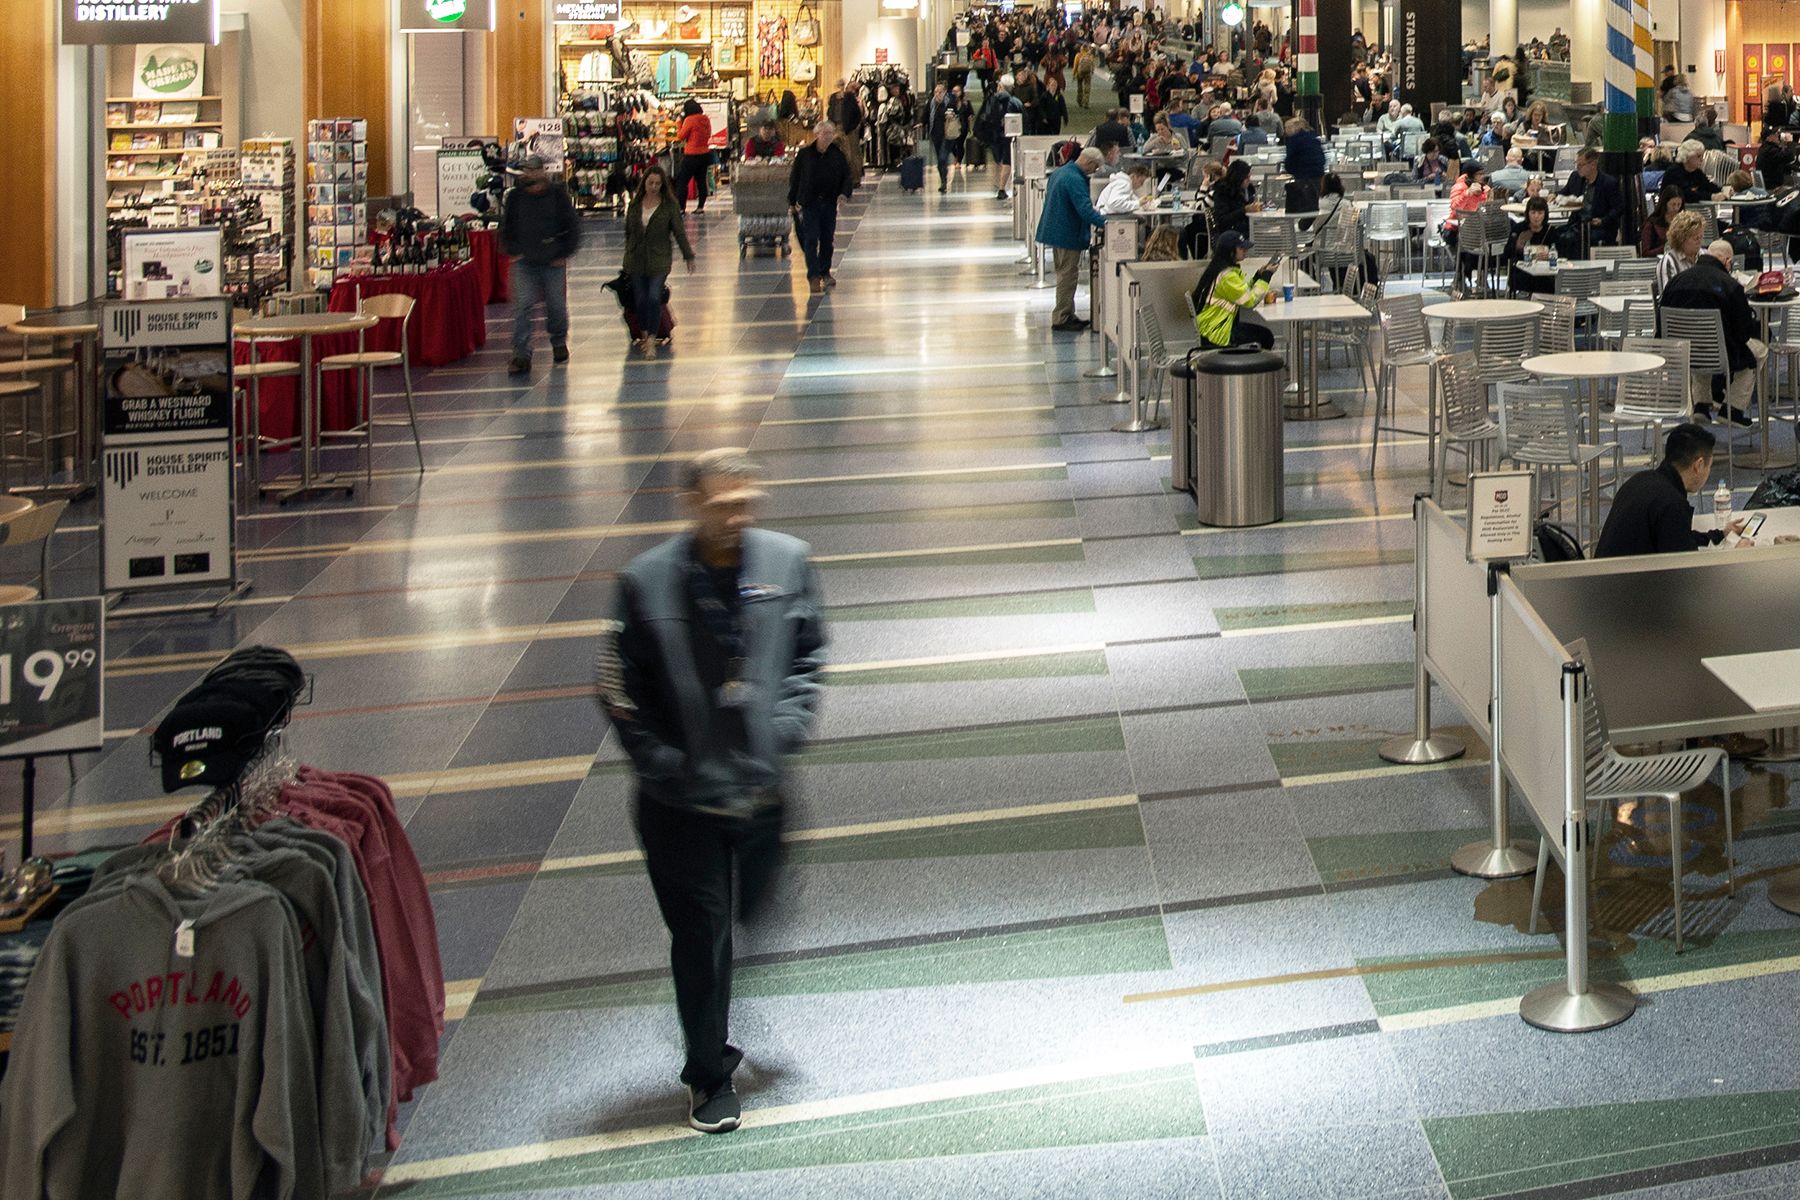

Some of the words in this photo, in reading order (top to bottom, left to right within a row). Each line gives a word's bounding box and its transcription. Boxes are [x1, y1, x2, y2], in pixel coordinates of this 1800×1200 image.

[76, 4, 170, 21] DISTILLERY
[1405, 11, 1416, 90] STARBUCKS
[147, 312, 180, 322] HOUSE
[183, 310, 218, 321] SPIRITS
[147, 321, 200, 332] DISTILLERY
[122, 398, 148, 411] GRAB
[150, 398, 156, 409] A
[158, 395, 212, 408] WESTWARD
[128, 409, 171, 422] WHISKEY
[173, 407, 206, 420] FLIGHT
[147, 454, 184, 466] HOUSE
[188, 451, 230, 462] SPIRITS
[147, 463, 208, 476] DISTILLERY
[140, 488, 198, 501] WELCOME
[173, 726, 223, 749] PORTLAND
[107, 968, 252, 1023] PORTLAND
[130, 1027, 166, 1067] EST.
[180, 1022, 240, 1066] 1851
